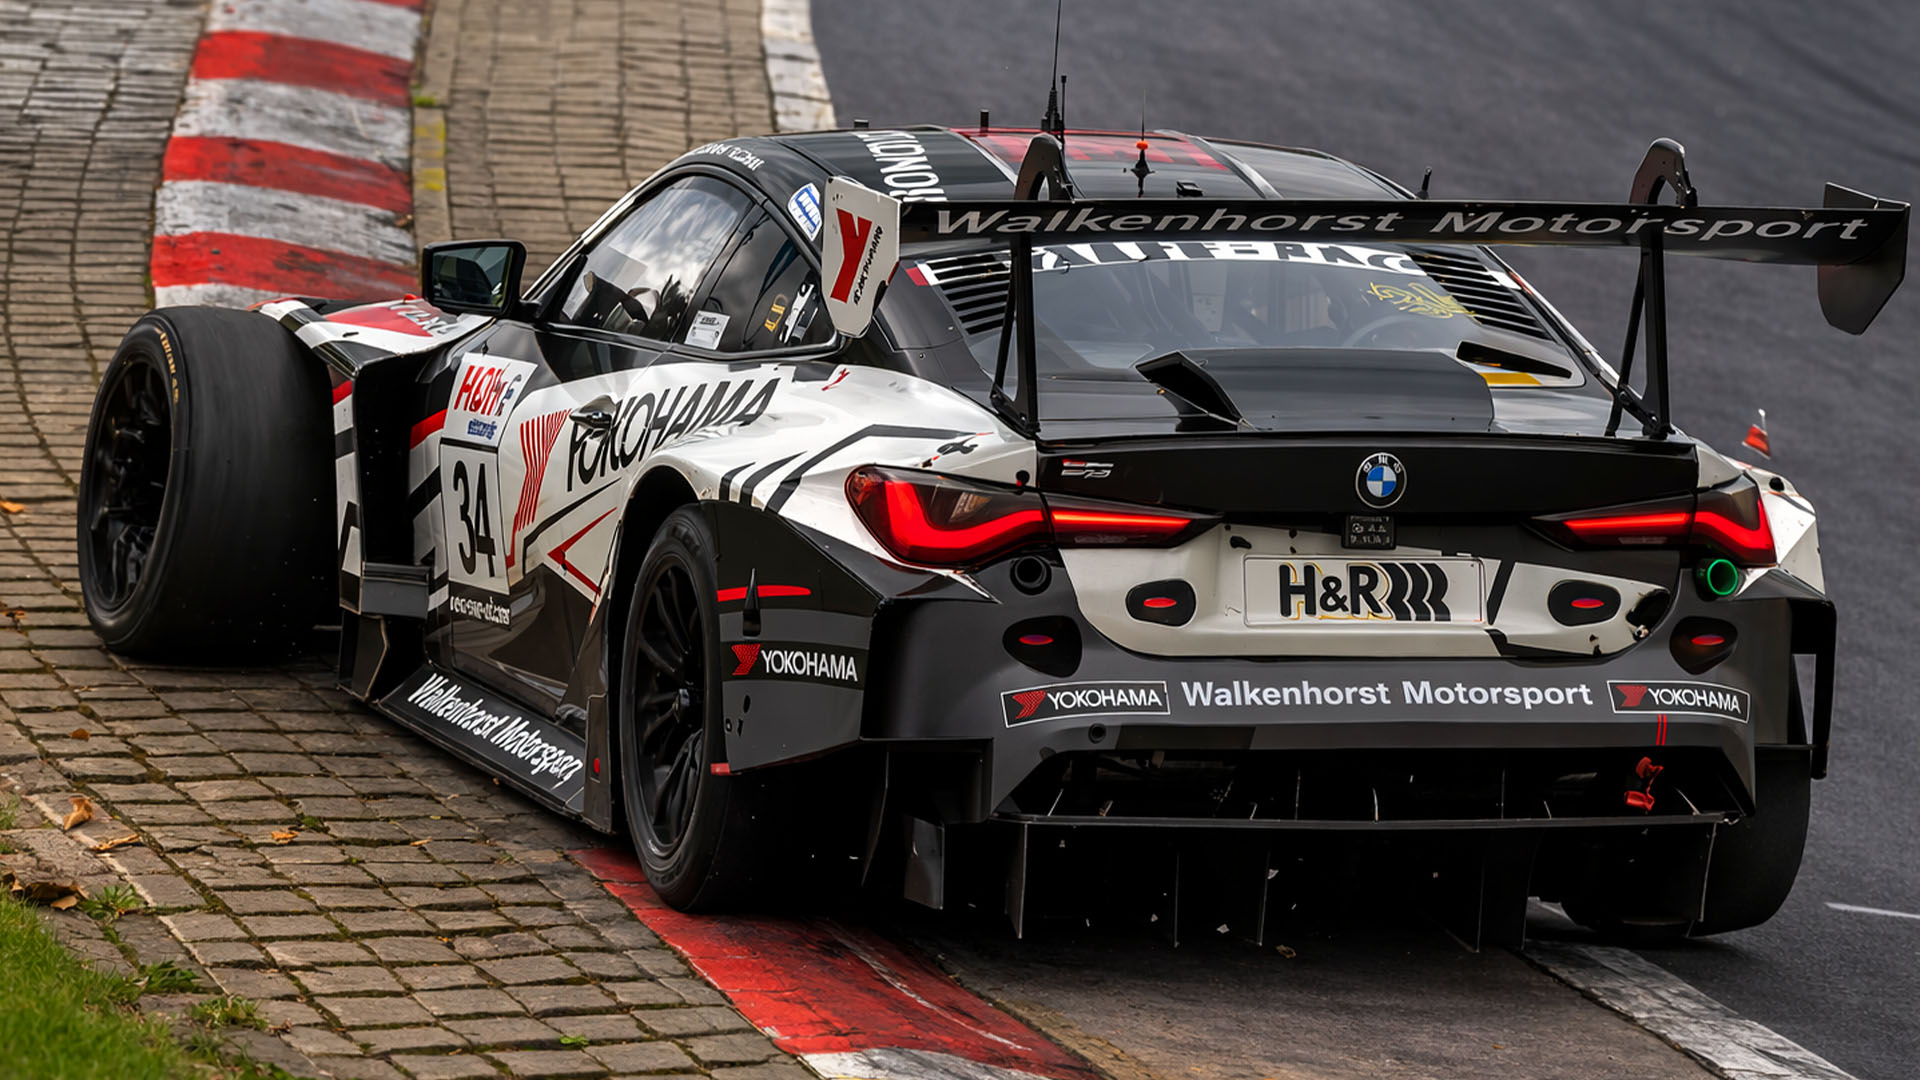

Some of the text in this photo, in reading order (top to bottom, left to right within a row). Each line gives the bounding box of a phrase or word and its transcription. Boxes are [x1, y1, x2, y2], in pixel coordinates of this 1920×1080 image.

[936, 207, 1869, 241] Walkenhorst Motorsport
[453, 460, 496, 578] 34
[1279, 562, 1385, 619] H&R
[761, 649, 858, 682] YOKOHAMA
[1047, 689, 1163, 710] YOKOHAMA
[1182, 681, 1594, 710] Walkenhorst Motorsport
[1648, 688, 1742, 714] YOKOHAMA
